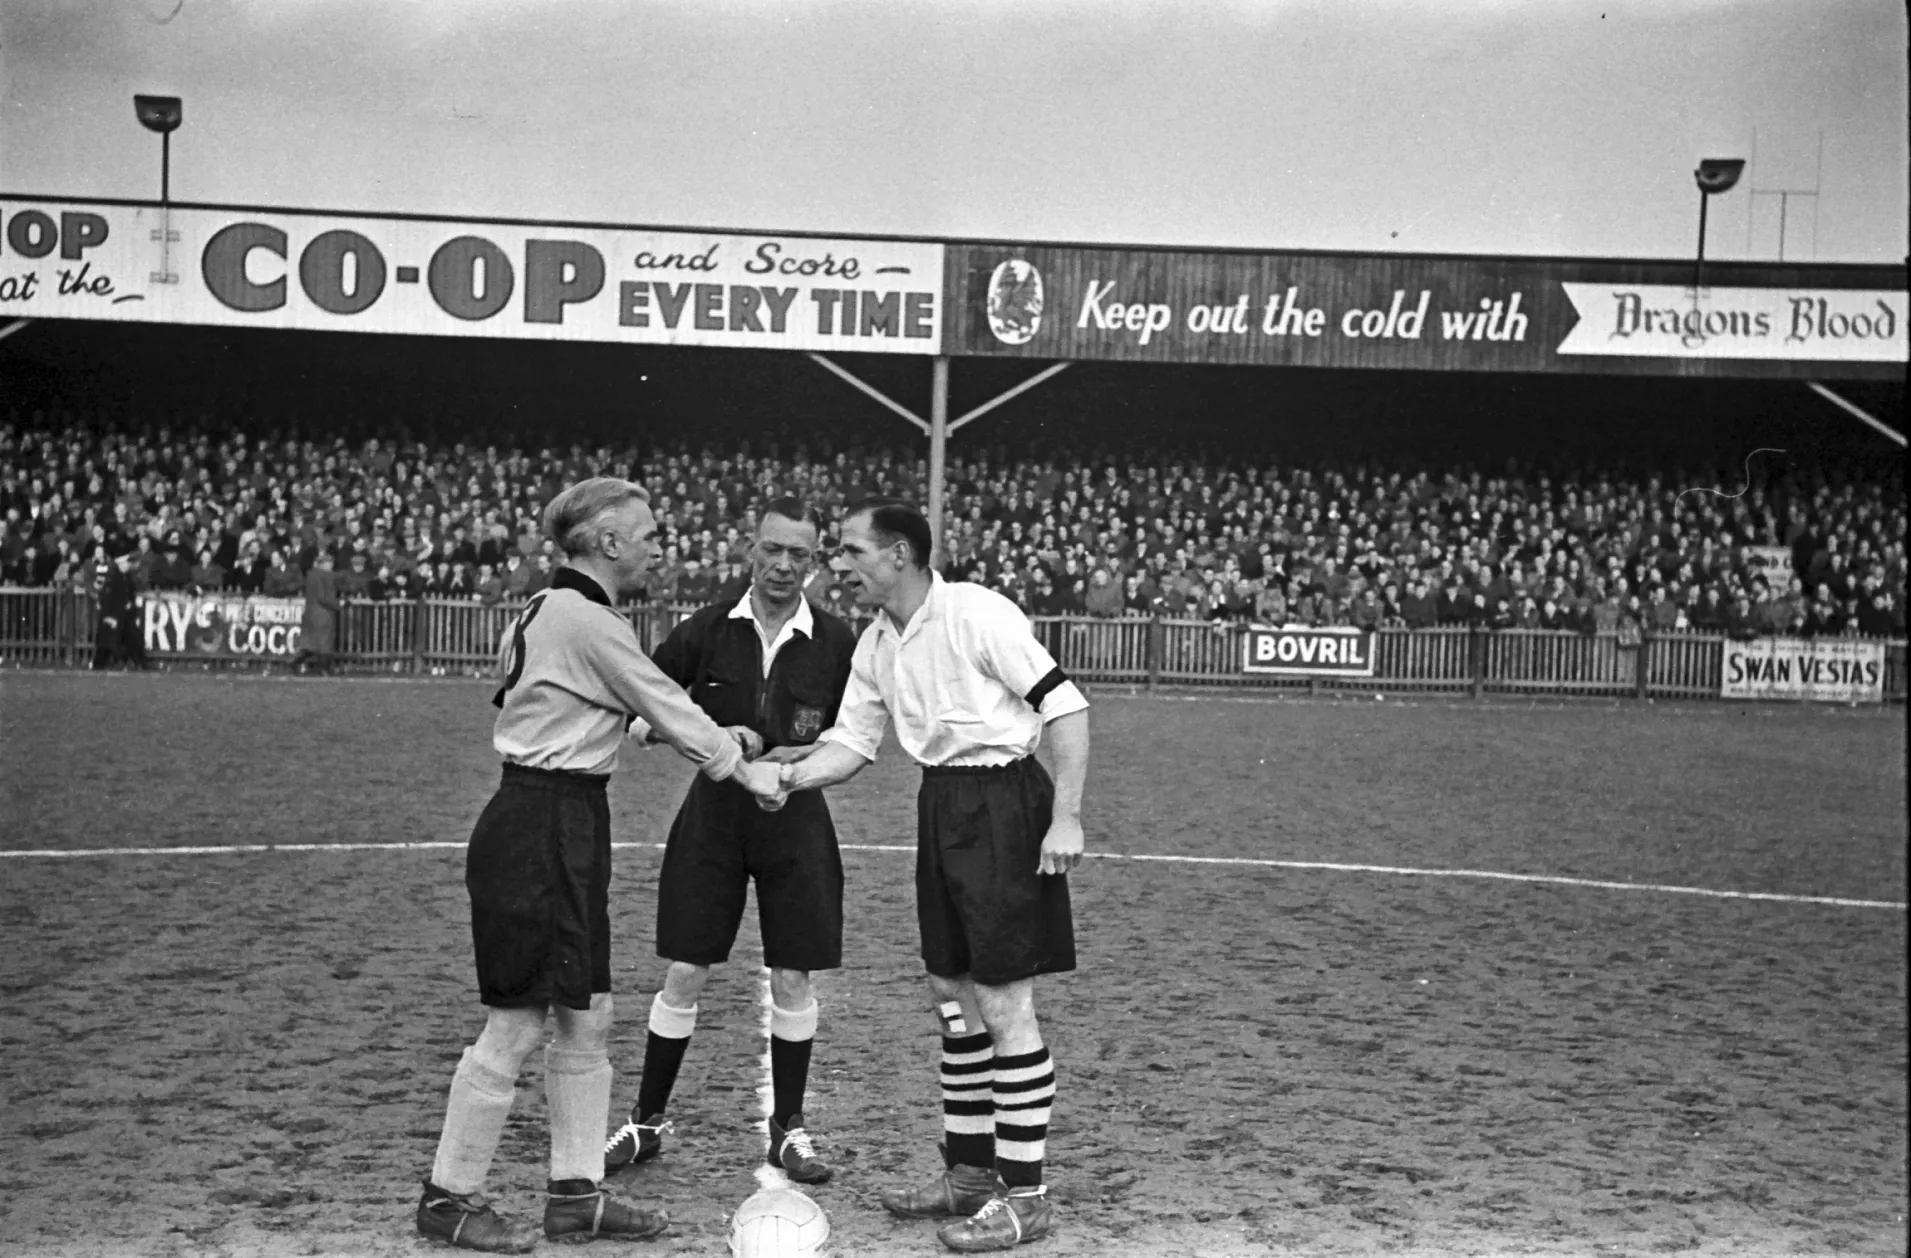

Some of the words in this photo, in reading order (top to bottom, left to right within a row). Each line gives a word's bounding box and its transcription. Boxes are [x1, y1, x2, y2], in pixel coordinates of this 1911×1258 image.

[0, 209, 109, 260] OP
[0, 270, 40, 302] at
[57, 261, 115, 296] the
[202, 222, 606, 325] CO-OP
[635, 243, 720, 272] and
[745, 243, 861, 279] Score
[619, 281, 799, 333] EVERY
[810, 288, 934, 339] TIME
[1077, 280, 1171, 345] Keep
[1187, 294, 1249, 334] out
[1262, 287, 1326, 337] the
[1341, 290, 1432, 339] cold
[1441, 291, 1529, 341] with
[1609, 292, 1770, 349] Dragons
[1784, 297, 1897, 343] Blood
[1256, 635, 1365, 664] BOVRIL
[1728, 652, 1790, 684] SWAN
[1799, 655, 1878, 685] VESTAS
